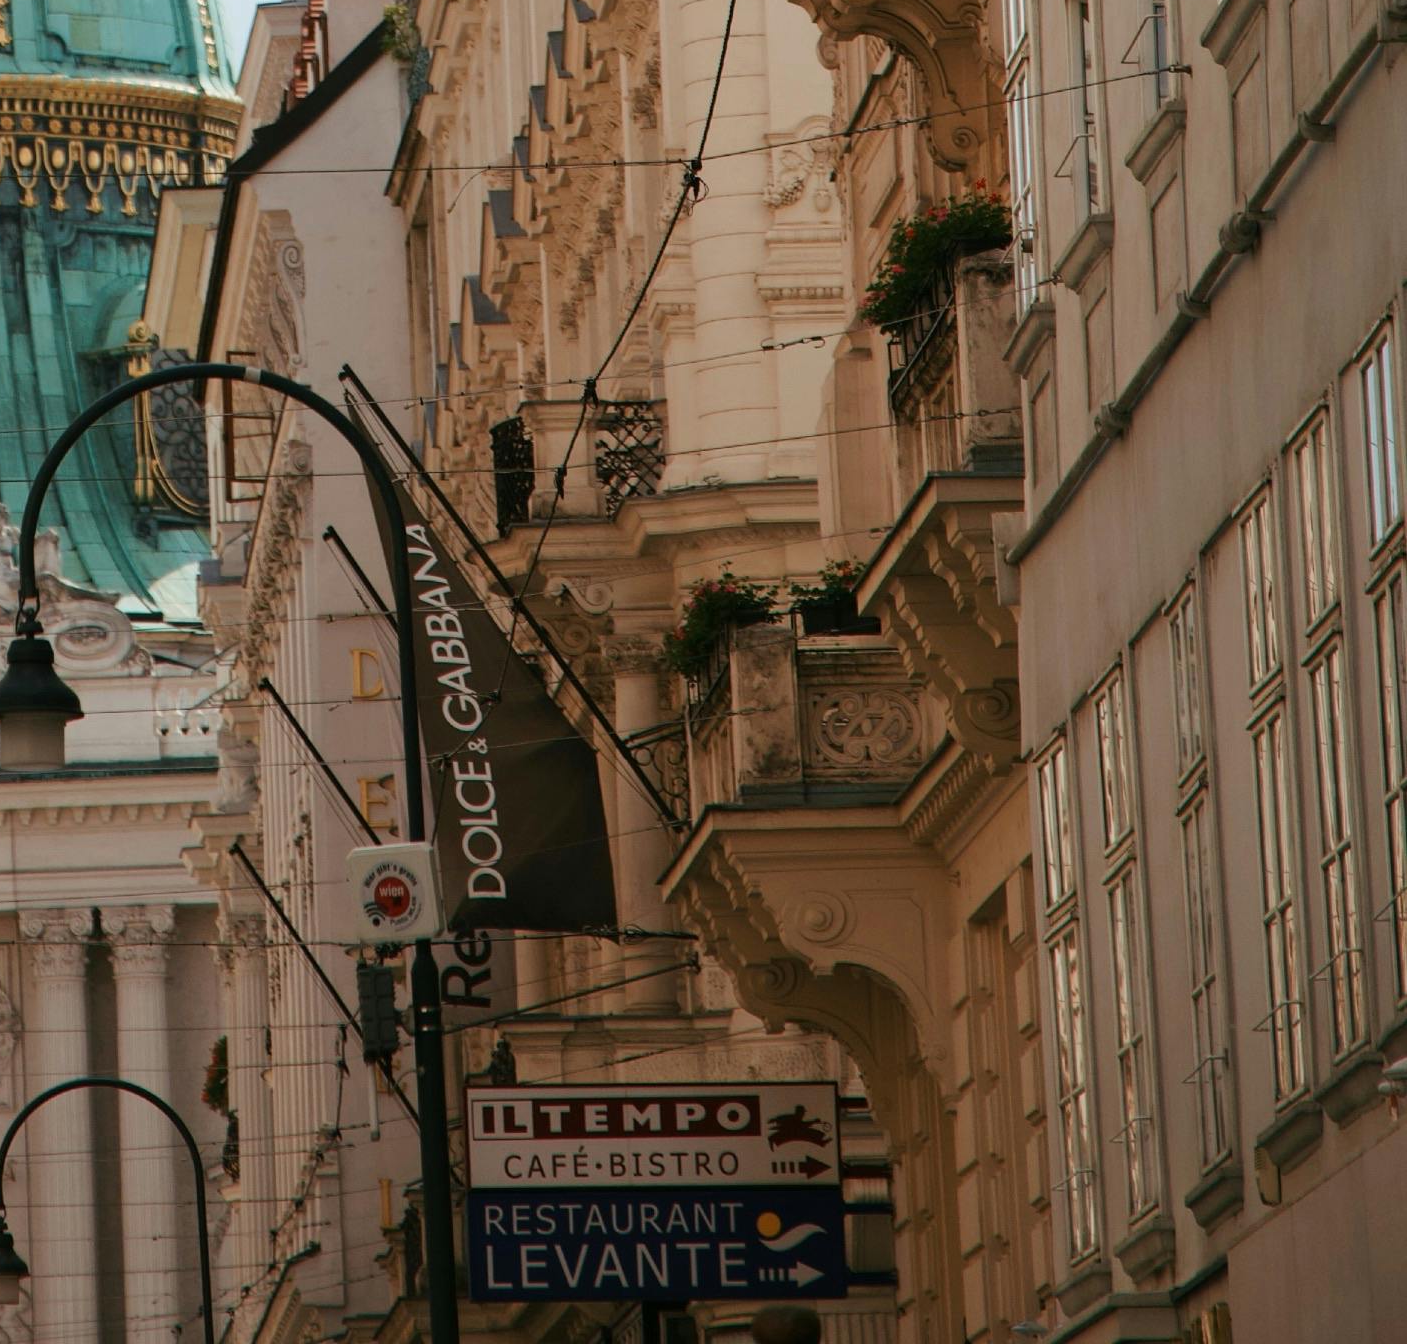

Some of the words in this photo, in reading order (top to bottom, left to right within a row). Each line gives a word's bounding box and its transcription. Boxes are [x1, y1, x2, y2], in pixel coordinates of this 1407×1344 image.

[405, 524, 483, 732] GABBANA
[468, 738, 487, 754] &
[452, 761, 506, 899] DOLCE
[379, 883, 404, 897] wien
[482, 1104, 527, 1133] IL
[539, 1102, 751, 1133] TEMPO
[484, 1202, 743, 1235] RESTAURANT
[486, 1242, 748, 1289] LEVANTE
